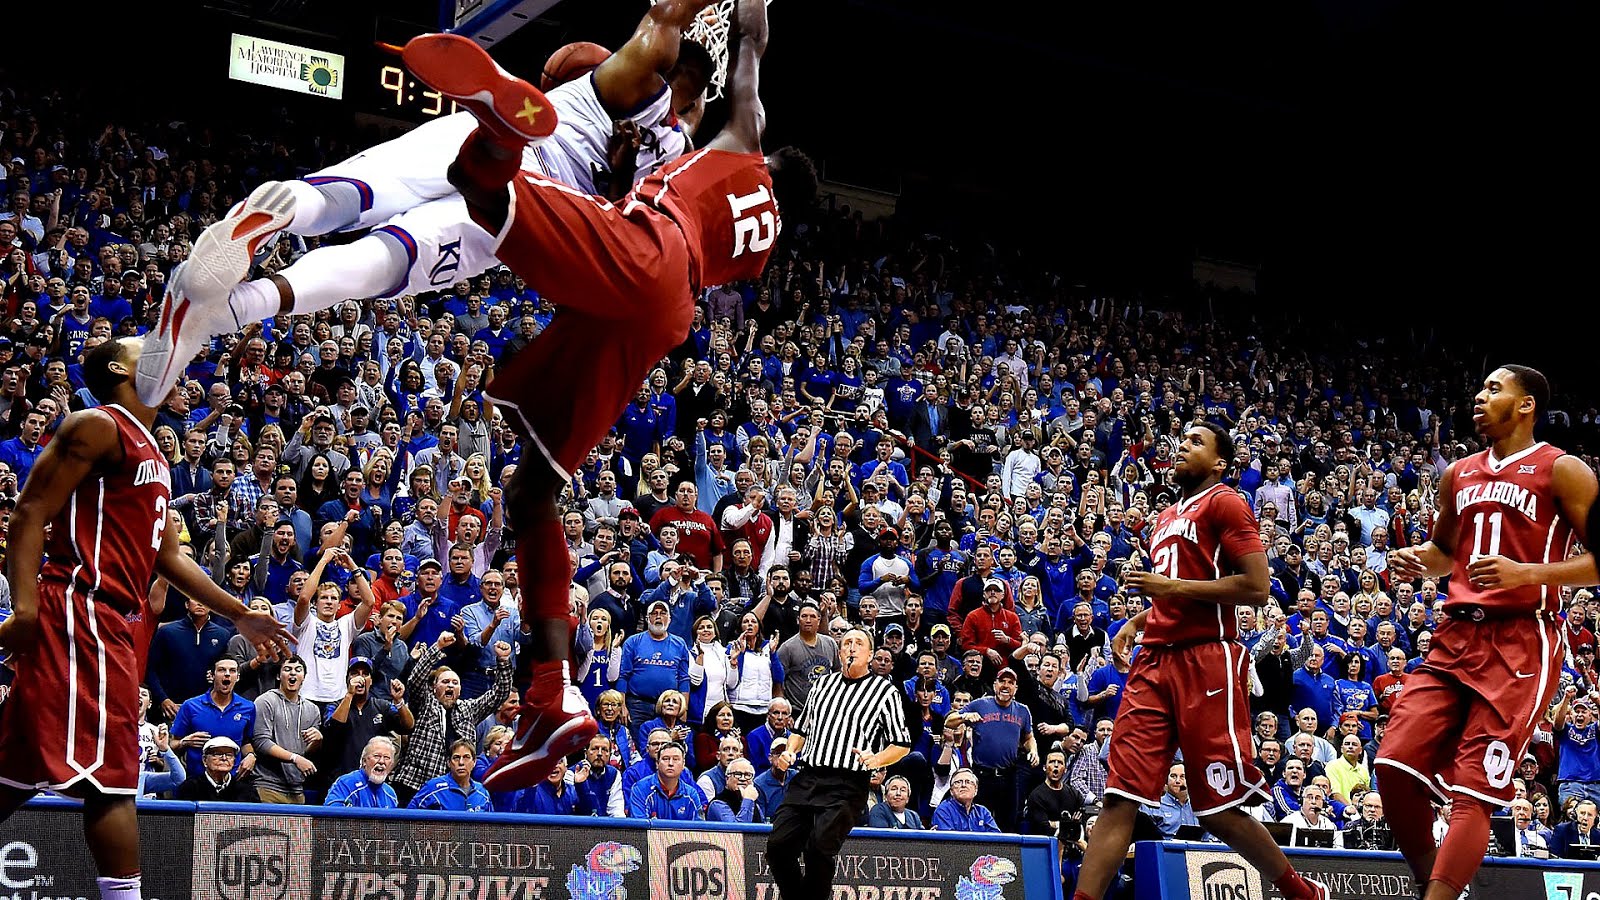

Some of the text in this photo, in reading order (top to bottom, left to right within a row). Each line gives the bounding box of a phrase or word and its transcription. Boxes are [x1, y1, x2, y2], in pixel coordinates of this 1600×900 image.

[238, 46, 296, 70] MEMORIAL
[252, 41, 307, 62] LAWRENCE
[251, 62, 300, 79] HOSPITAL
[726, 184, 775, 258] 12
[428, 236, 462, 286] KU
[1456, 481, 1537, 521] OKLAHOMA
[1469, 512, 1502, 562] 11
[1152, 543, 1179, 580] 21
[1206, 761, 1235, 797] OU
[1482, 740, 1515, 789] OU
[322, 838, 464, 868] JAYHAWK
